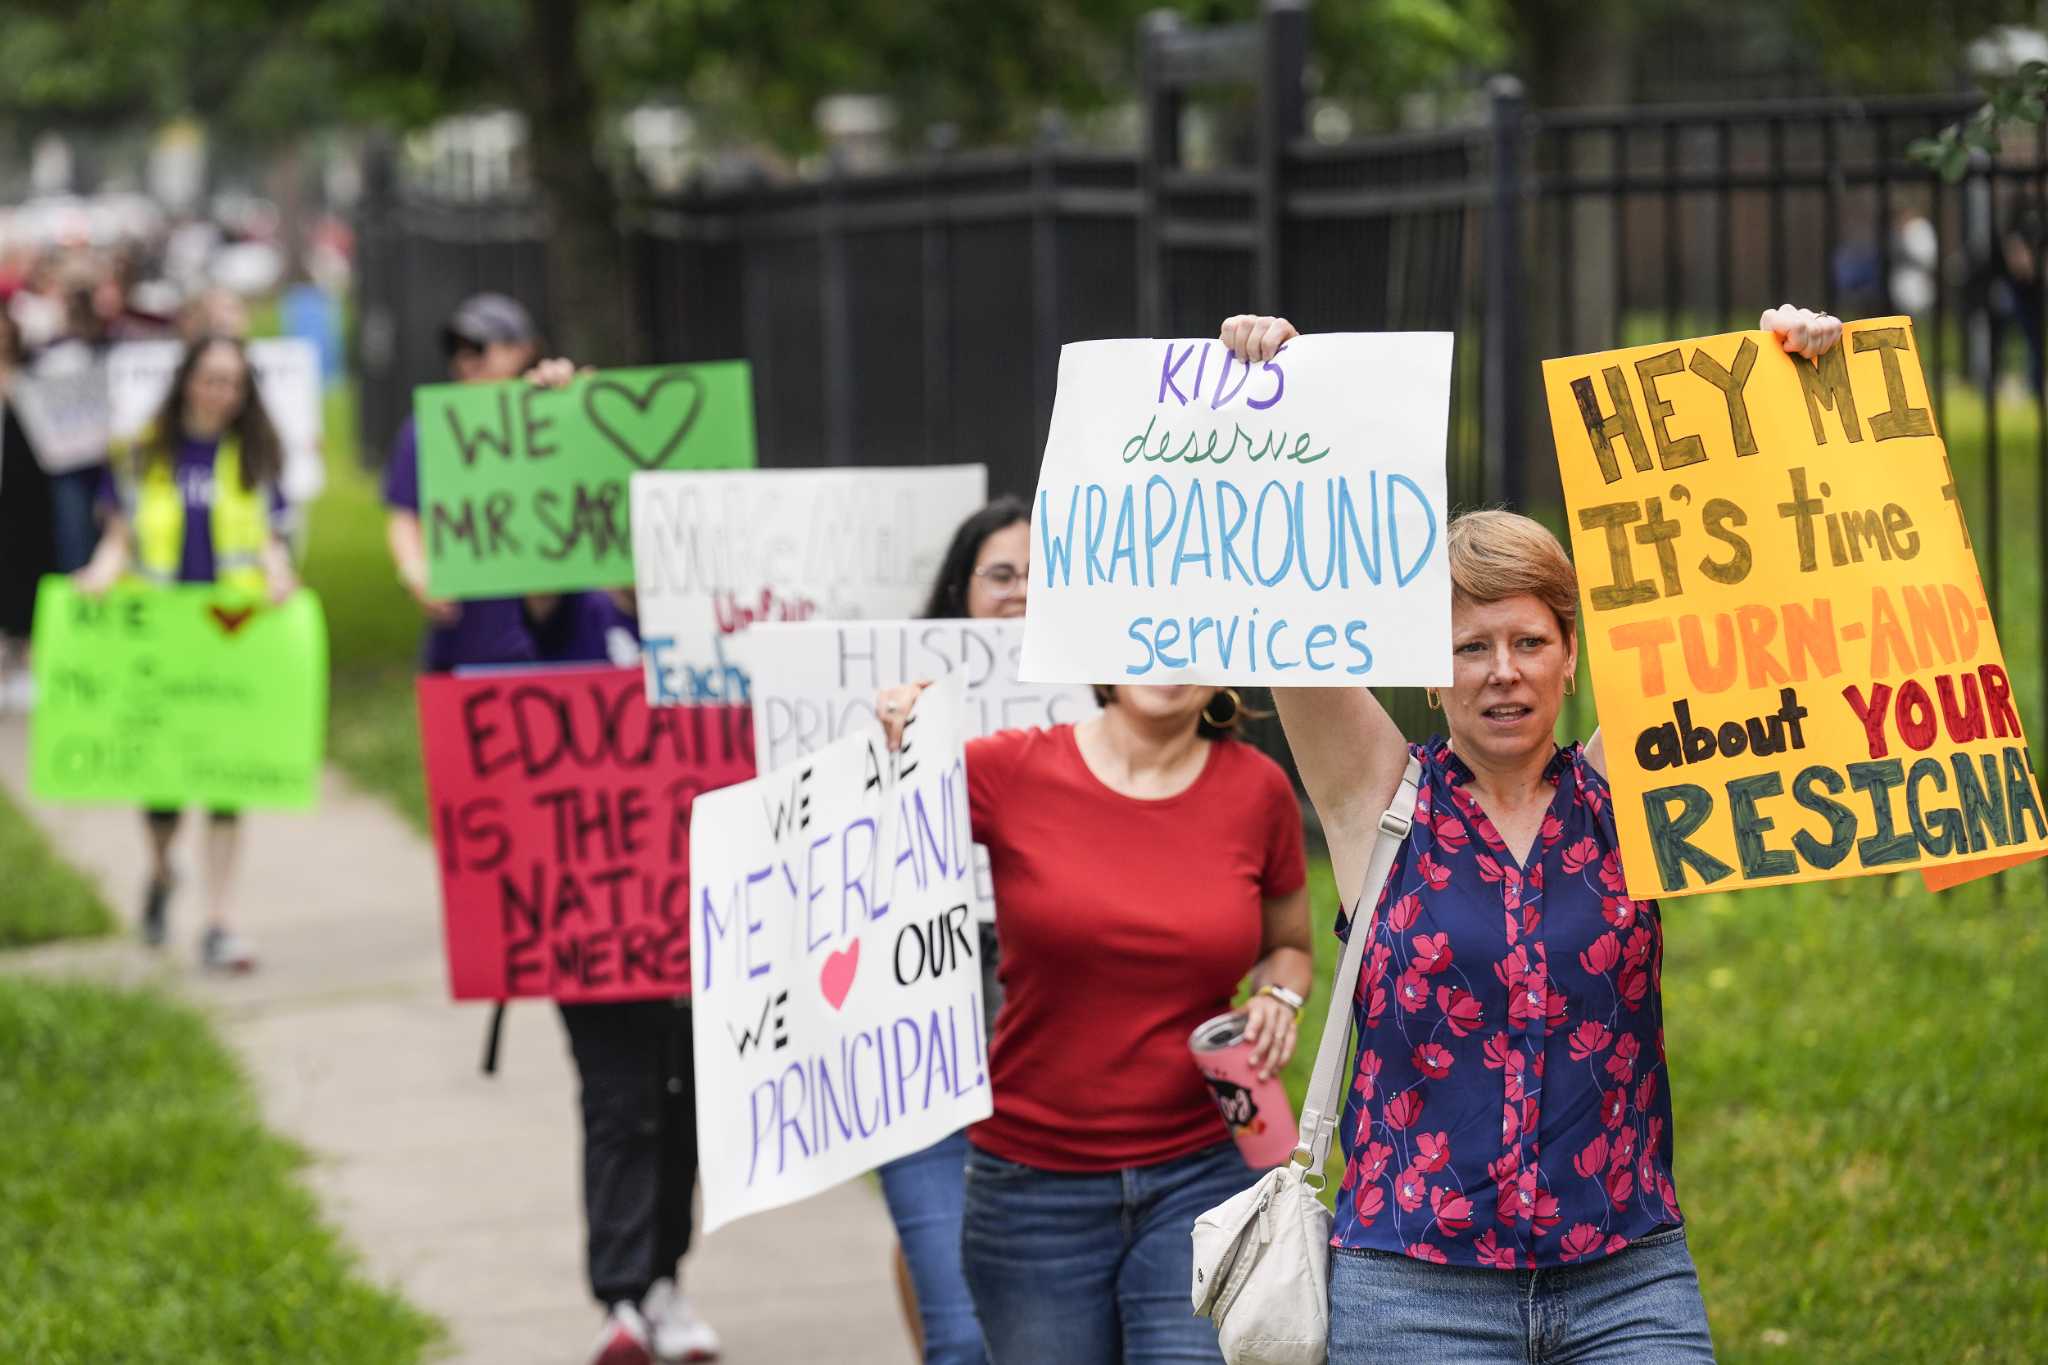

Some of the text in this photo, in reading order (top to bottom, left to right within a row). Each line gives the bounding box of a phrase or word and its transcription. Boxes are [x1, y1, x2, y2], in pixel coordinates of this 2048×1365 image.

[445, 386, 559, 467] WE
[1158, 342, 1288, 411] KIDS
[1570, 327, 1936, 484] HEY MI
[1123, 415, 1331, 464] deserve
[431, 489, 523, 563] MR
[1041, 470, 1437, 591] WRAPAROUND
[1578, 482, 1752, 611] It's
[1778, 466, 1921, 572] time
[640, 634, 753, 701] Teach
[1126, 607, 1374, 675] services
[1635, 664, 2021, 772] about YOUR
[441, 797, 513, 877] IS
[533, 785, 648, 865] THE
[763, 767, 812, 843] WE
[1642, 744, 2048, 893] RESIGNA
[702, 757, 968, 993] MEYERLAND
[727, 904, 973, 1058] WE OUR
[747, 993, 985, 1188] PRINCIPAL!
